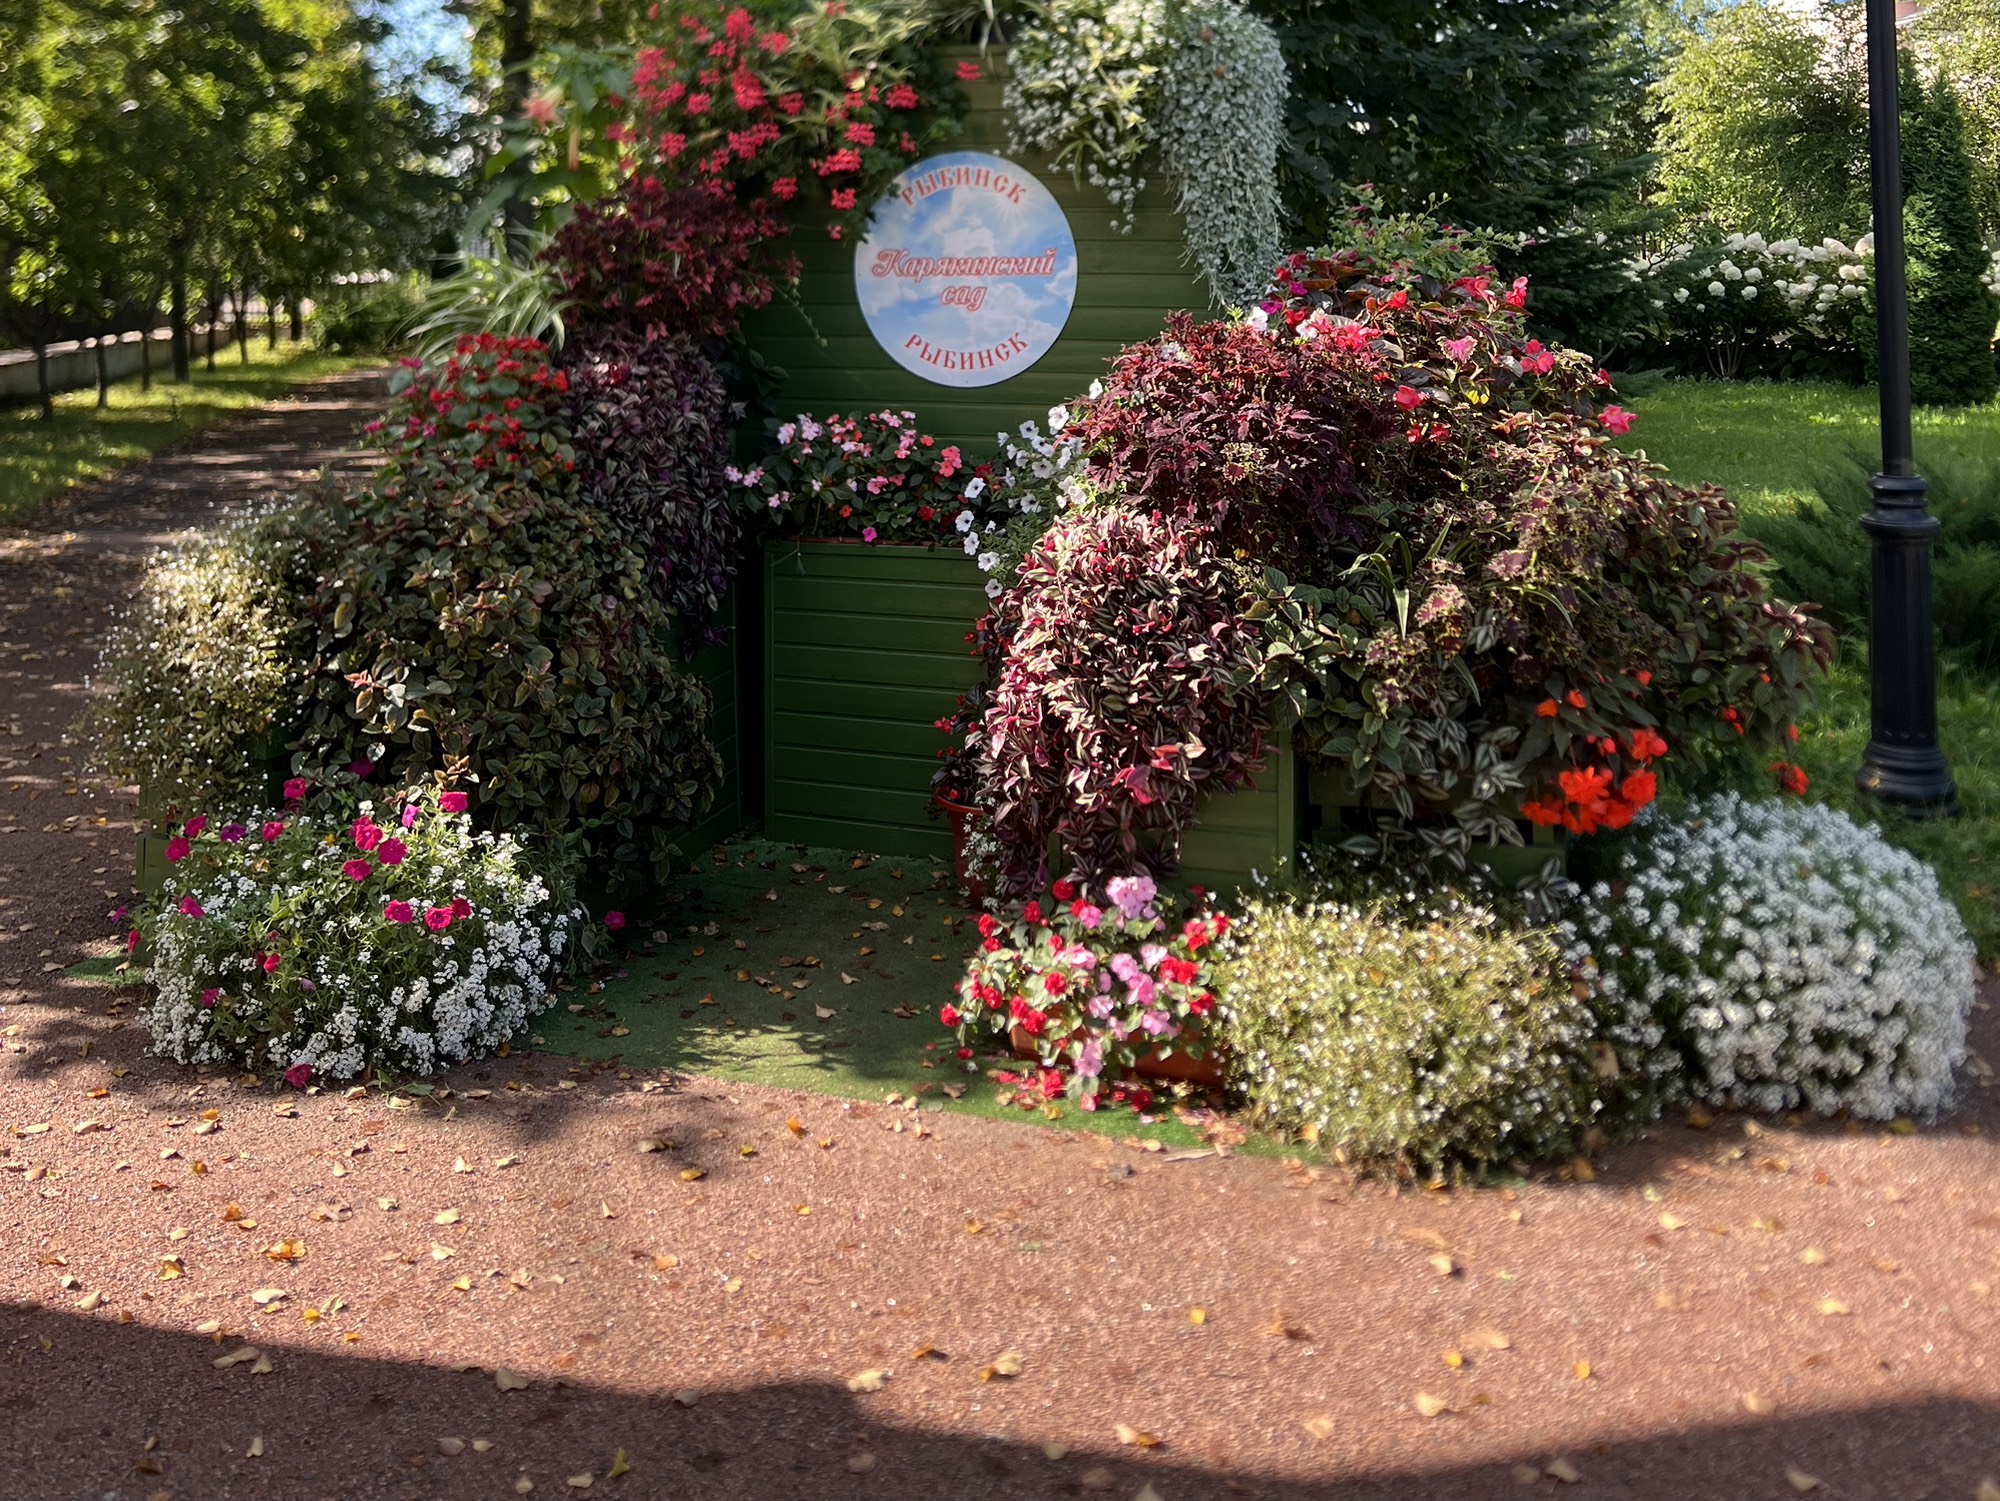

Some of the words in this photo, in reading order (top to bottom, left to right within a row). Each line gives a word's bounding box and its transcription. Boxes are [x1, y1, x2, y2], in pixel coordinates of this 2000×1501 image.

[901, 166, 1027, 207] РЫБИНСК
[872, 249, 1057, 283] Карякинский
[941, 286, 987, 311] сад
[904, 332, 1029, 370] РЫБИНСК
